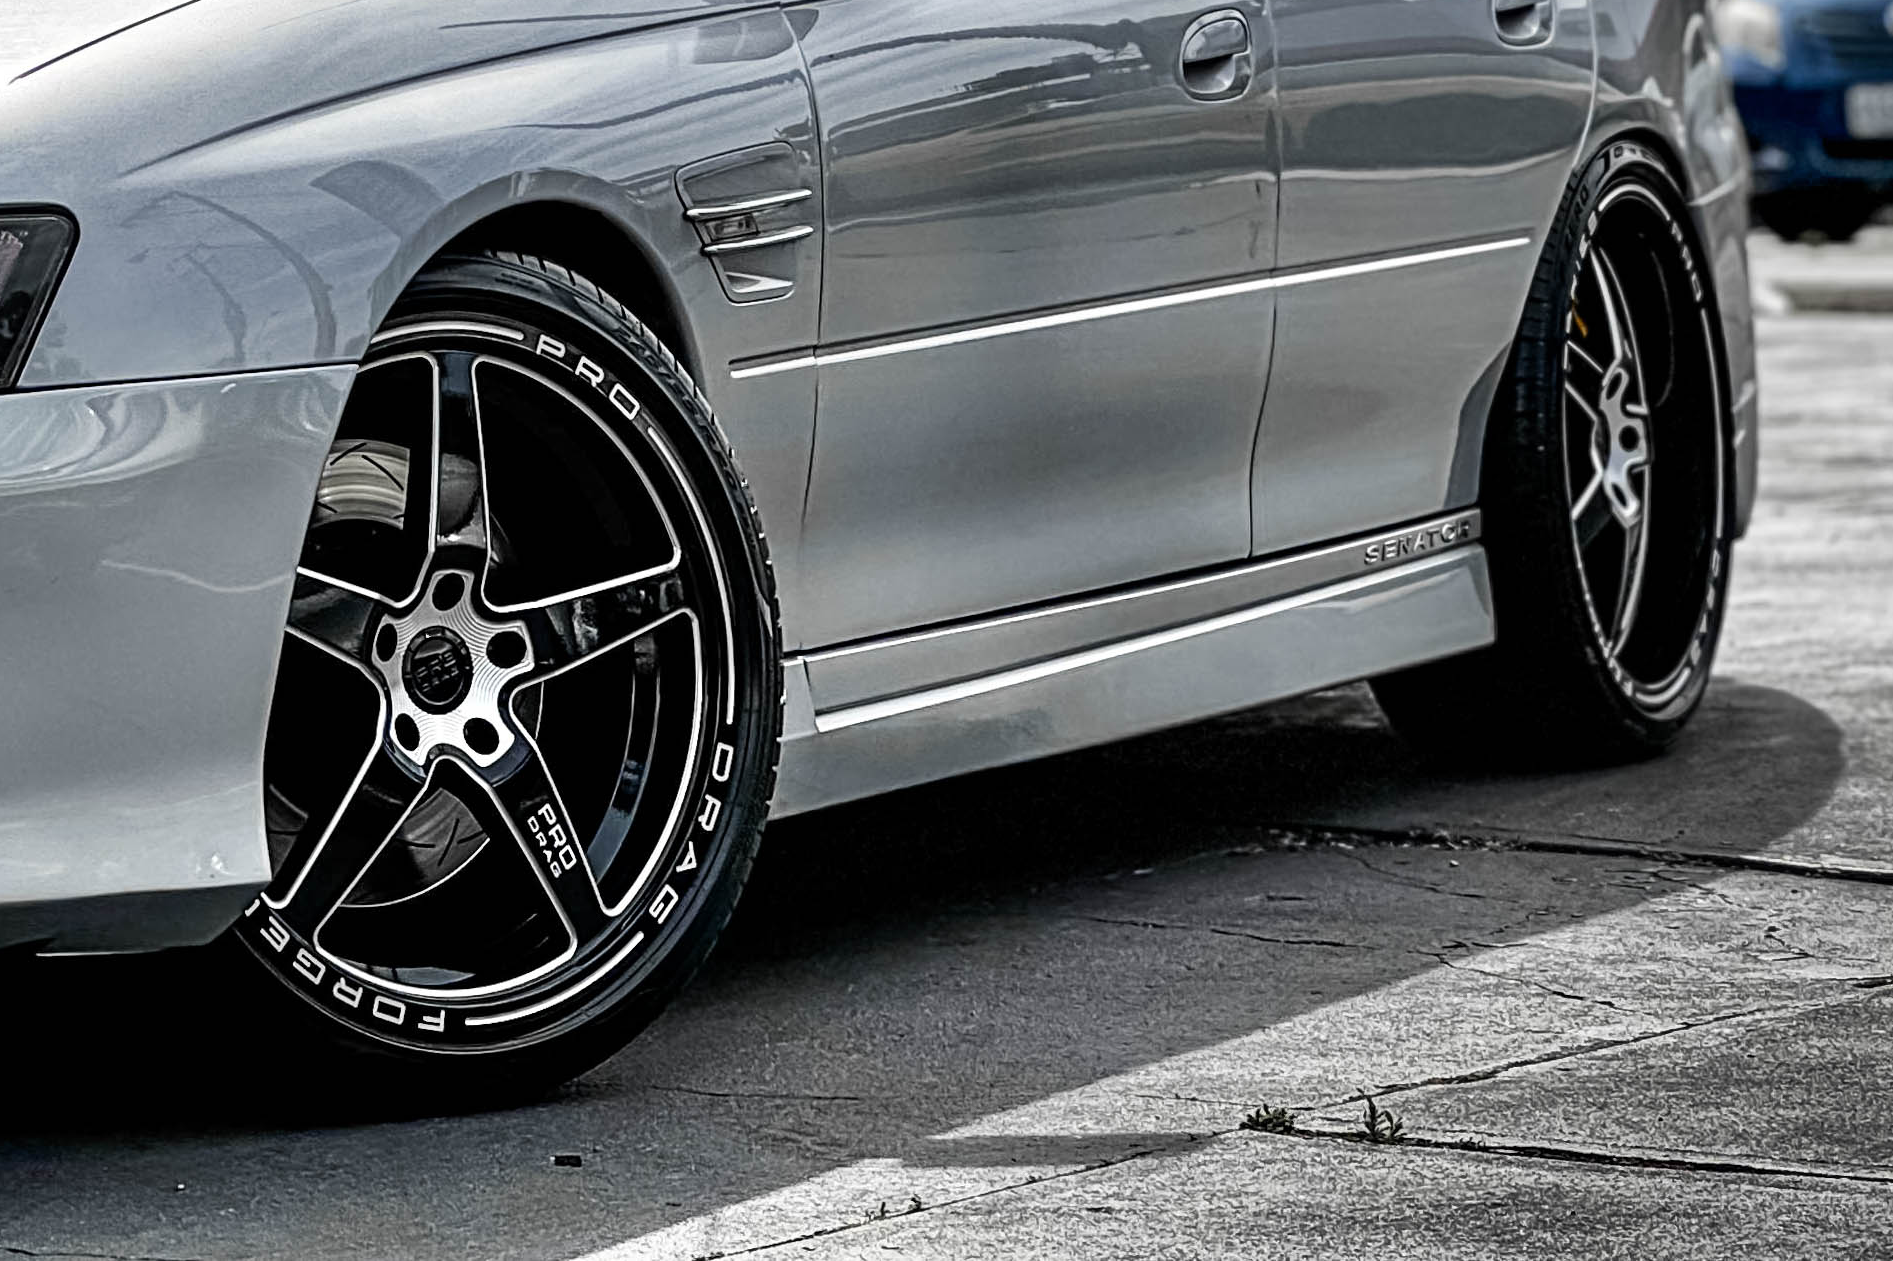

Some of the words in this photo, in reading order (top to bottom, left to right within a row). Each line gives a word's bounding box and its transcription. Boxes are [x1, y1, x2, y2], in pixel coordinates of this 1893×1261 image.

[535, 333, 642, 421] PRO
[1364, 519, 1472, 565] SENATOR
[526, 815, 563, 879] DRAG
[537, 802, 578, 871] PRO
[648, 741, 735, 926] DRAG
